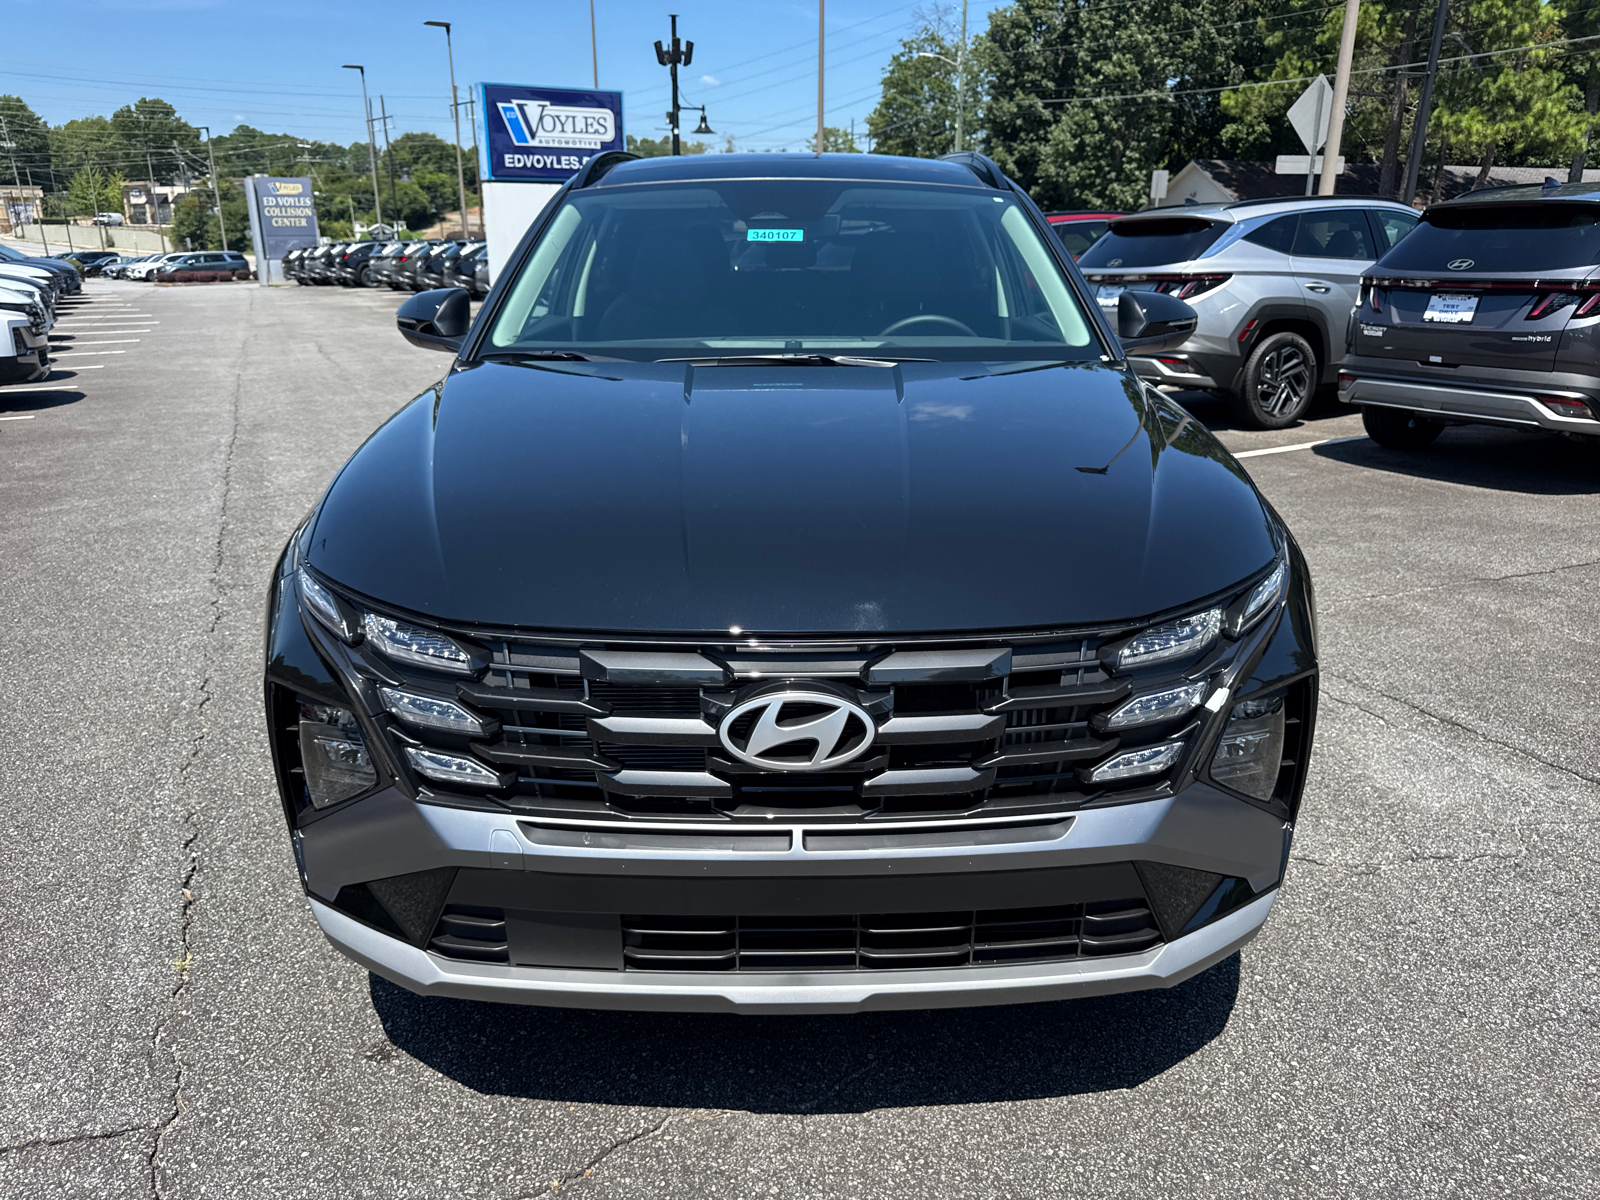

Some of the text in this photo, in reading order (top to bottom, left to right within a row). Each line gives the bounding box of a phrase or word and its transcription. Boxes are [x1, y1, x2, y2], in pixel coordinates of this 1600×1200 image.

[515, 103, 608, 140] VOYLES
[538, 138, 599, 147] AUTOMOTIVE
[262, 196, 312, 207] ED VOYLES
[264, 207, 313, 217] COLLISION
[271, 217, 308, 227] CENTER
[752, 231, 797, 240] 340107
